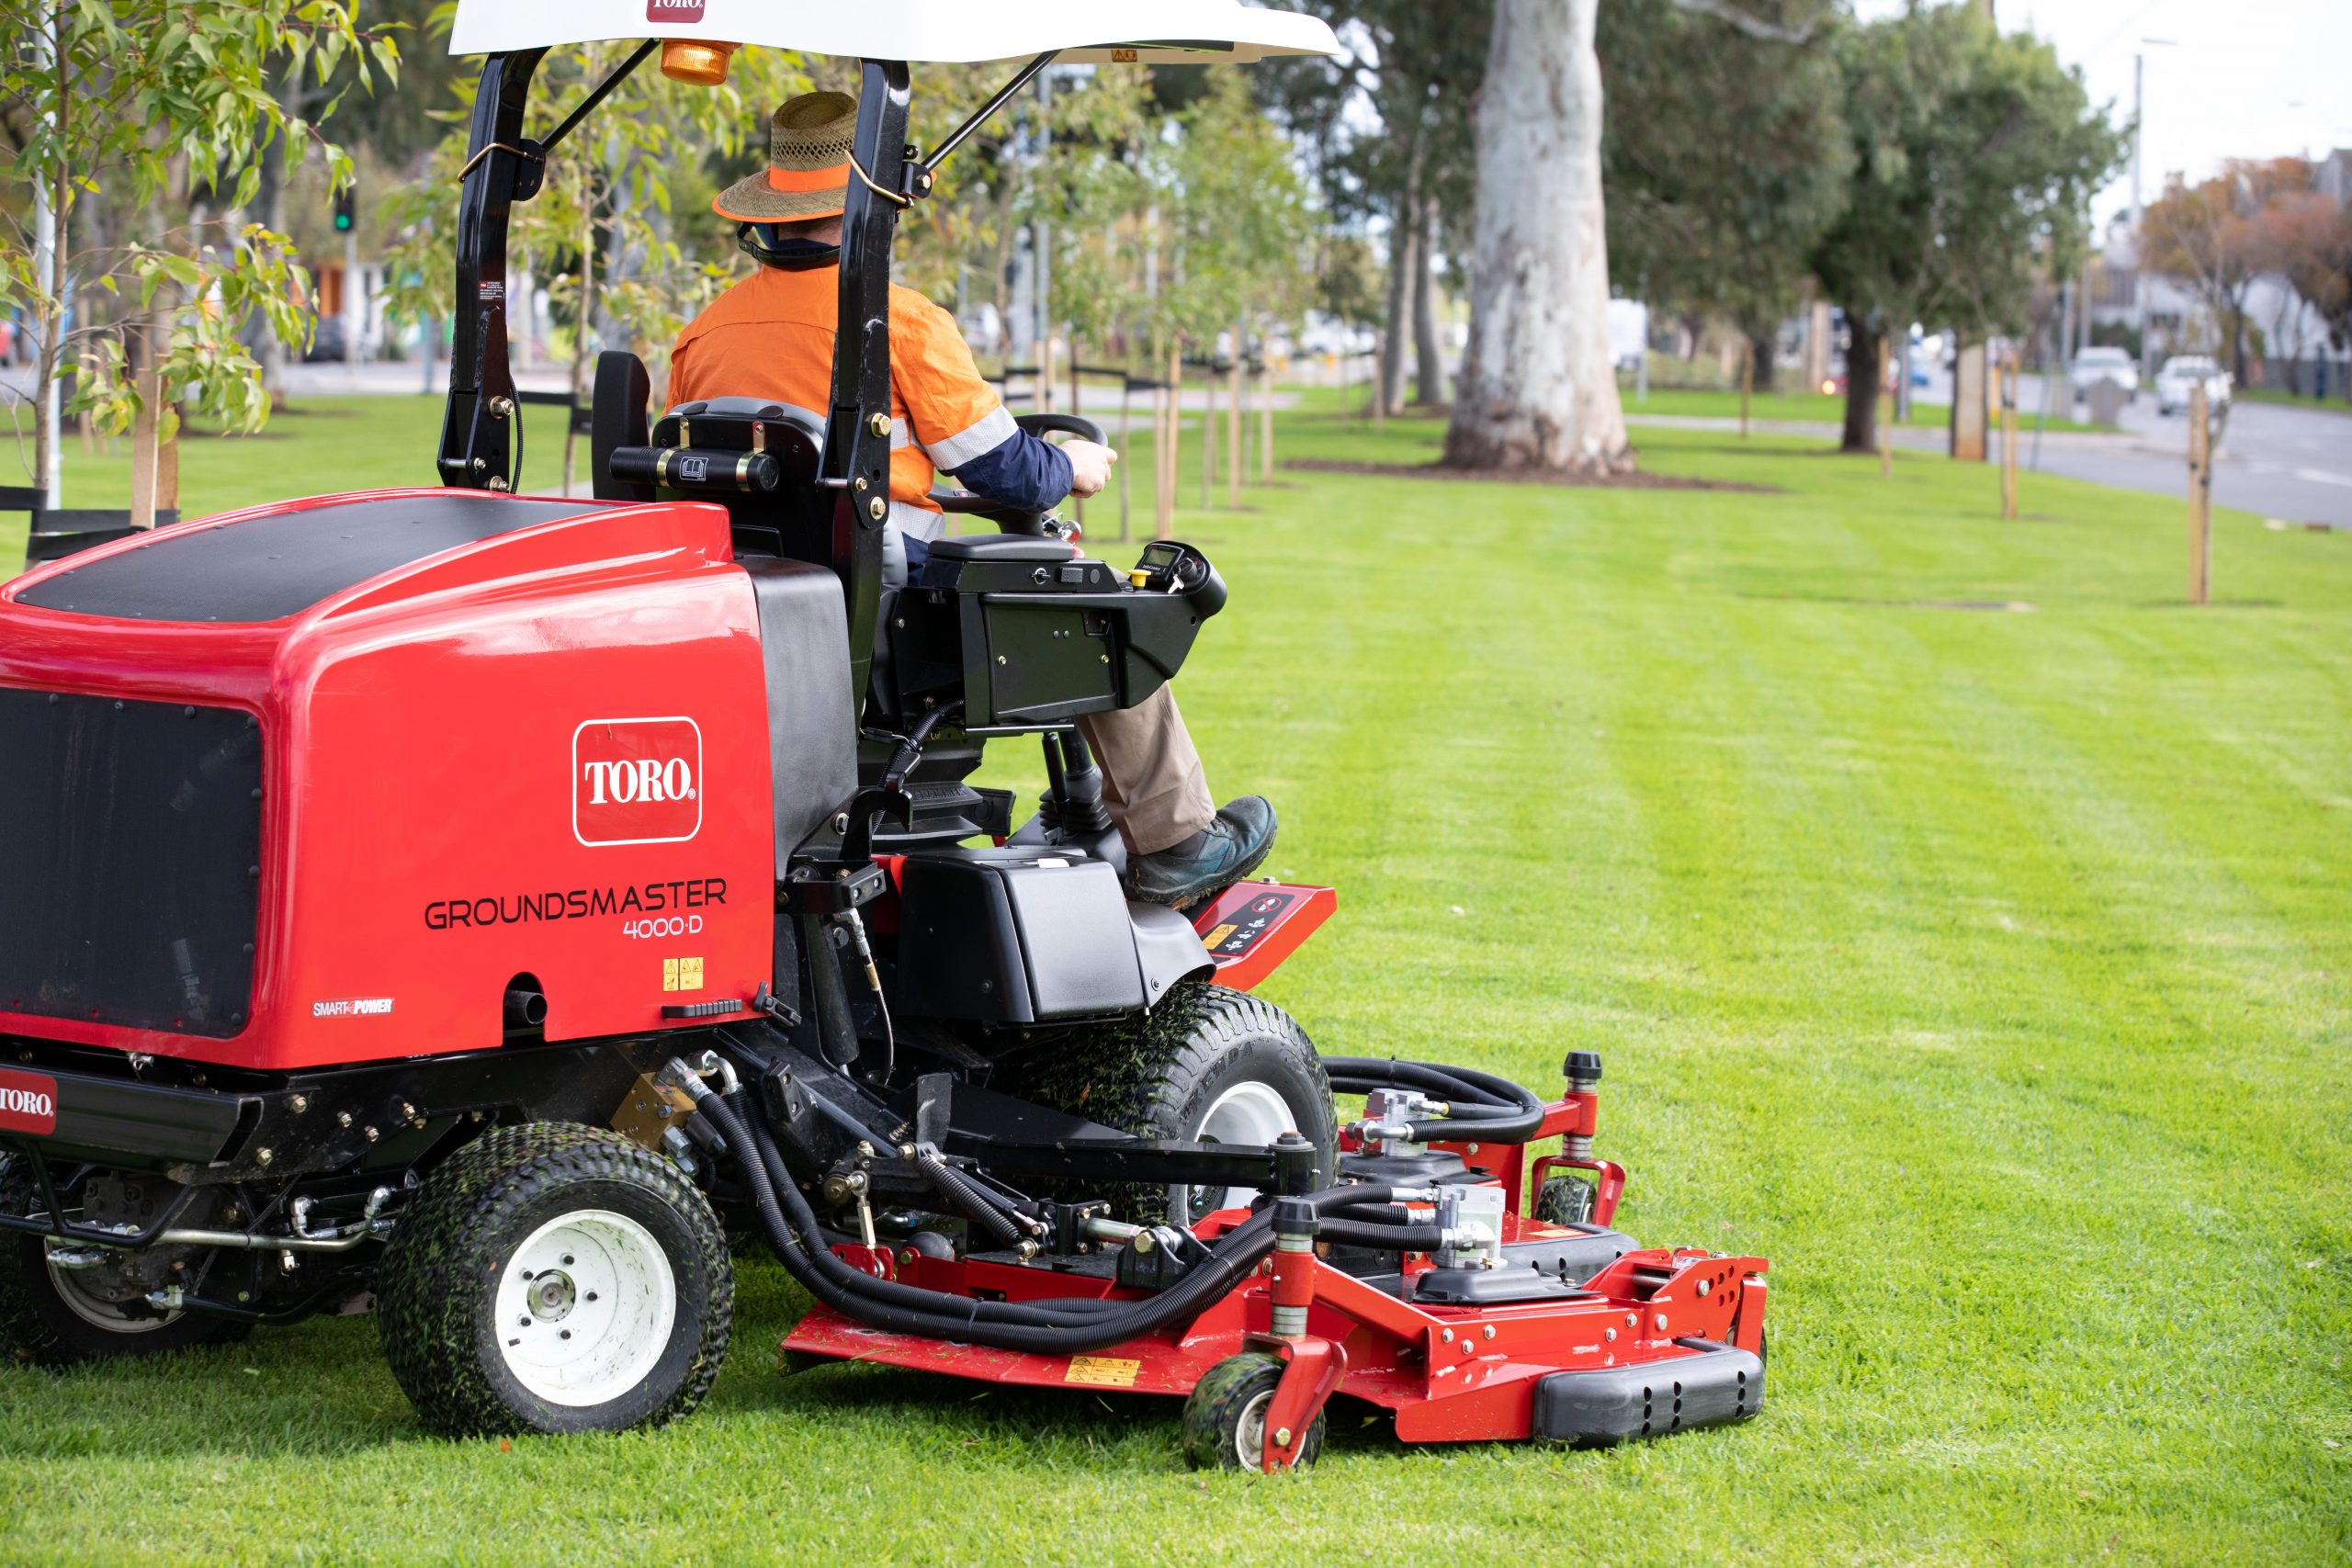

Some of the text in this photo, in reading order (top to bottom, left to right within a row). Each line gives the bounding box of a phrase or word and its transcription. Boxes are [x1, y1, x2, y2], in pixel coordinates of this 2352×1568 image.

[584, 757, 692, 805] TORO
[424, 877, 727, 930] GROUNDSMASTER
[313, 998, 392, 1016] SMART POWER
